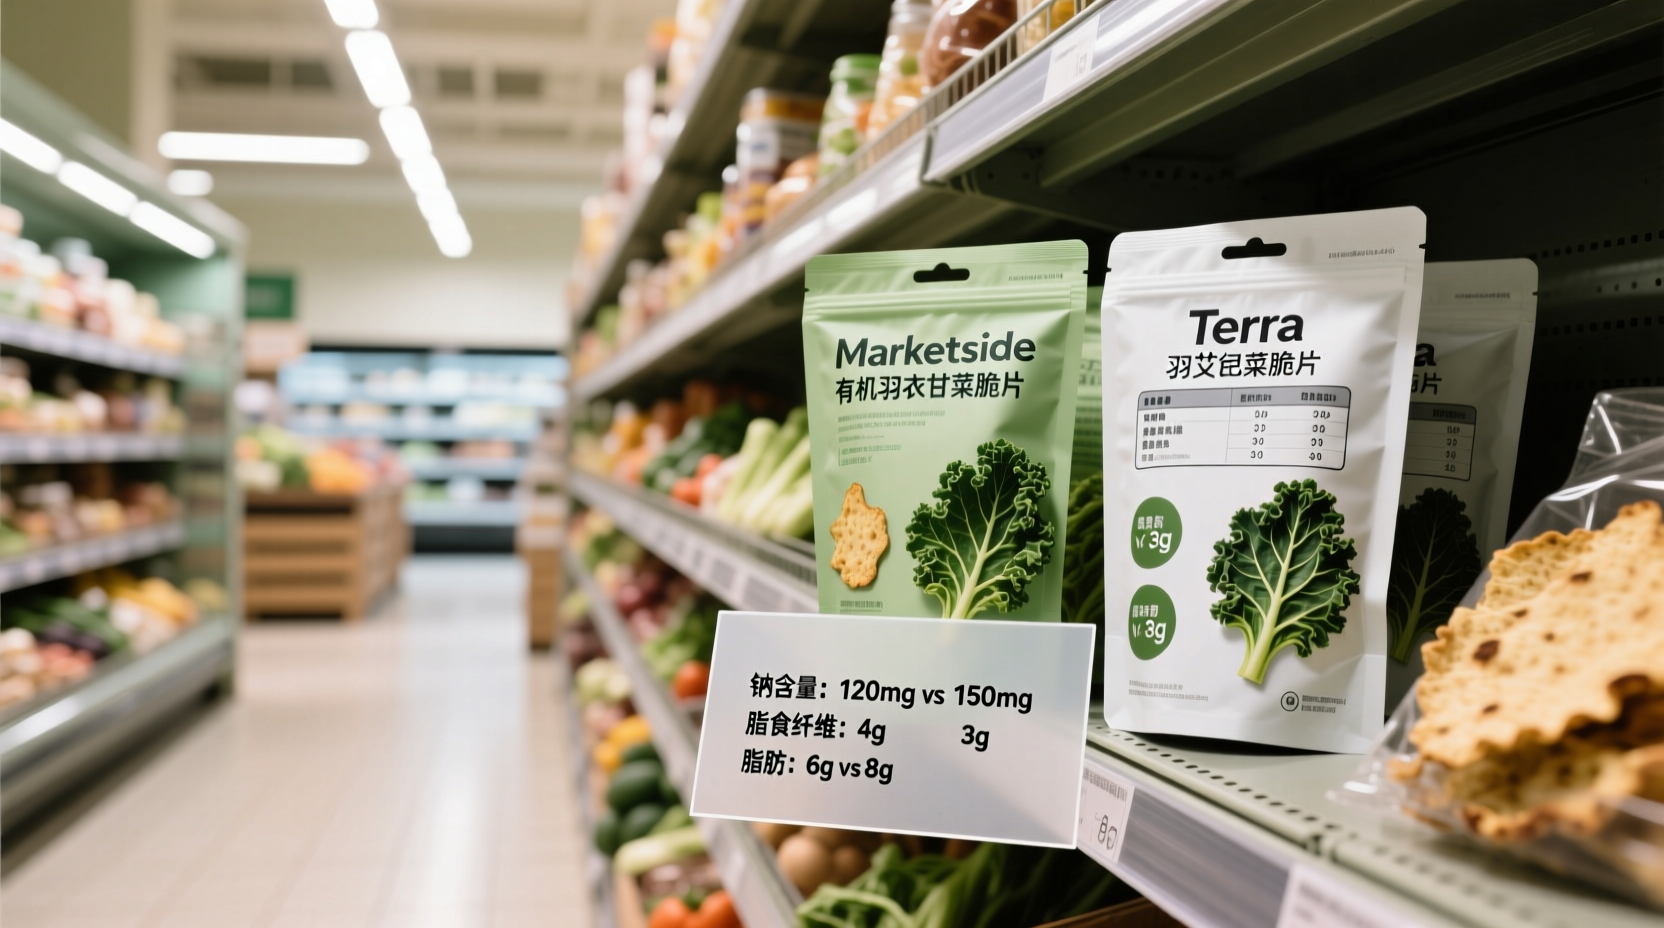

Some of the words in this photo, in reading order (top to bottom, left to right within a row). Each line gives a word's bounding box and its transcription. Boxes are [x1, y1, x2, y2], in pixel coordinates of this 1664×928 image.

[1189, 308, 1304, 346] Terra
[835, 330, 1037, 370] Marketside
[835, 370, 1025, 406] 有机羽衣甘菜脆片
[1148, 530, 1173, 554] 3g
[1144, 619, 1167, 645] 3g
[749, 672, 827, 700] 钠含量：
[840, 678, 916, 710] 120mg
[921, 688, 946, 705] vs
[954, 684, 1033, 715] 150mg
[857, 717, 887, 747] 4g
[960, 724, 990, 753] 3g
[740, 747, 795, 776] 脂肪：
[806, 753, 834, 782] 6g
[838, 761, 862, 778] vs
[864, 756, 894, 786] 8g
